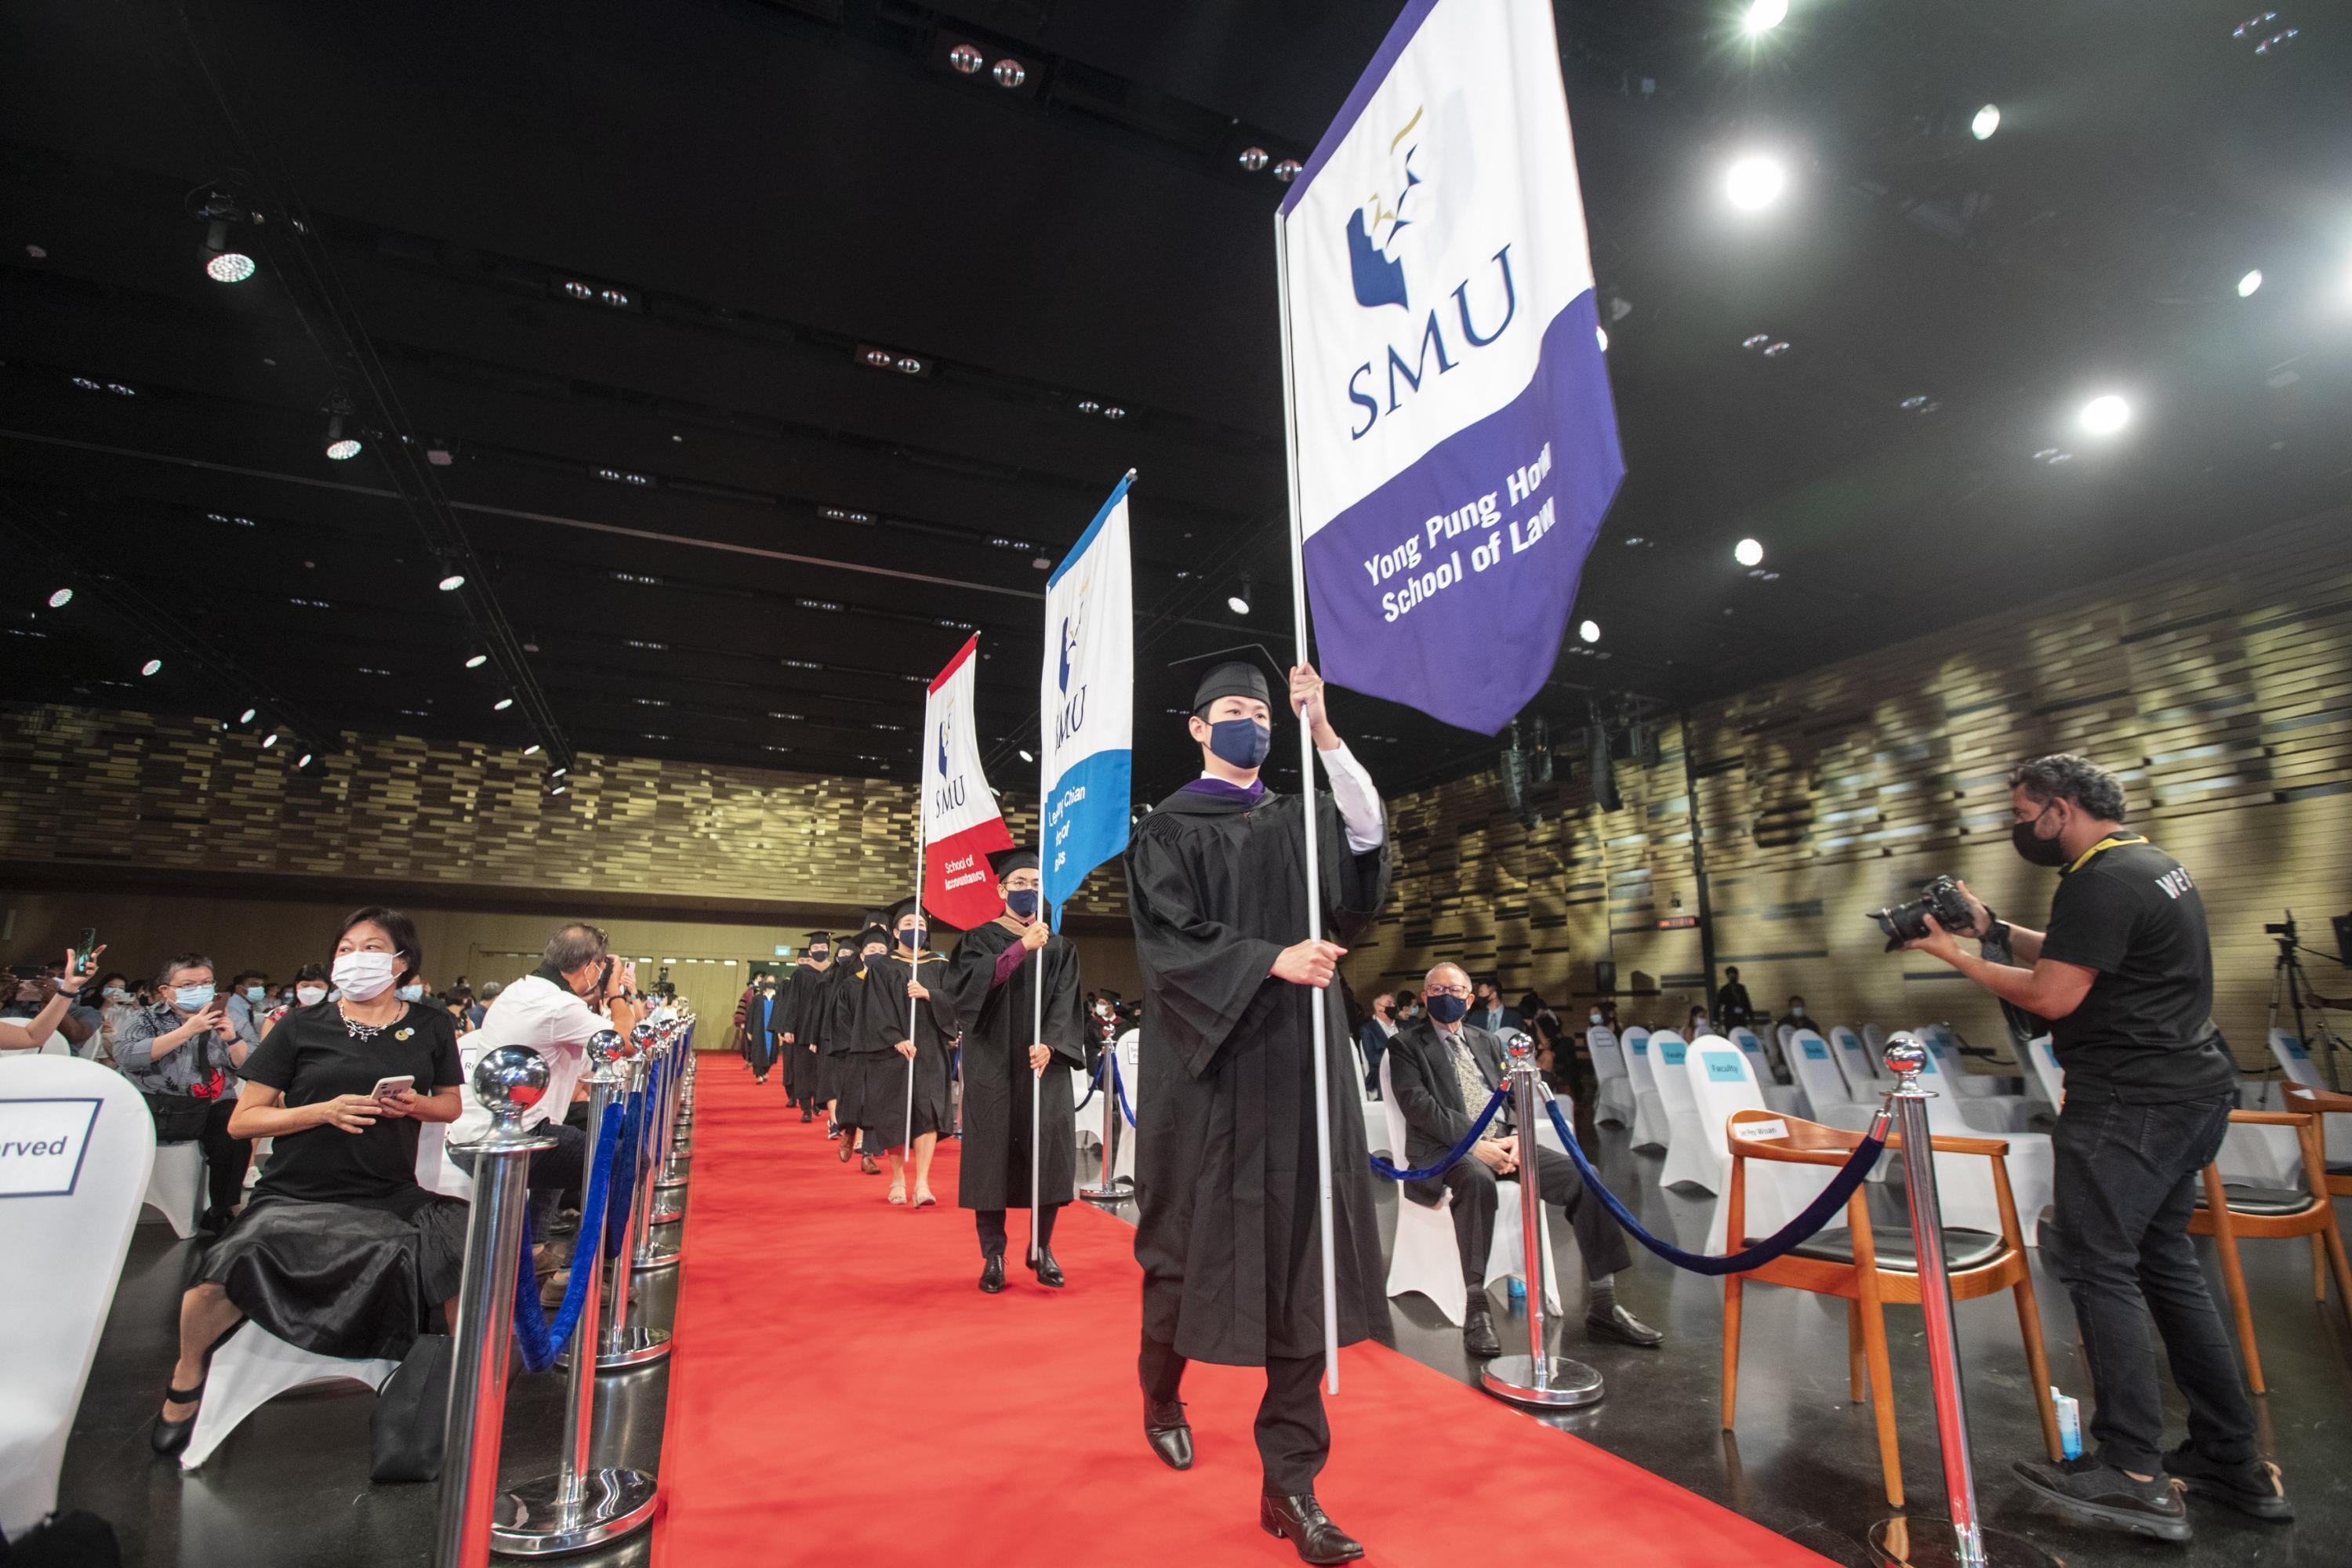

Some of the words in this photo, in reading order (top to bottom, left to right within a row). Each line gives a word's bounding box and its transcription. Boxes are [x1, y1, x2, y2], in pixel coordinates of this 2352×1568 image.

[1348, 242, 1515, 441] SMU
[1364, 534, 1422, 586] Yong
[1425, 491, 1501, 550] Pung
[1382, 550, 1463, 622] School
[1471, 530, 1501, 572] of
[1508, 495, 1556, 554] Law
[936, 775, 965, 818] SMU
[945, 857, 966, 874] School
[945, 870, 986, 891] Accountancy
[1711, 1064, 1738, 1074] Faculty
[0, 1135, 68, 1157] rved
